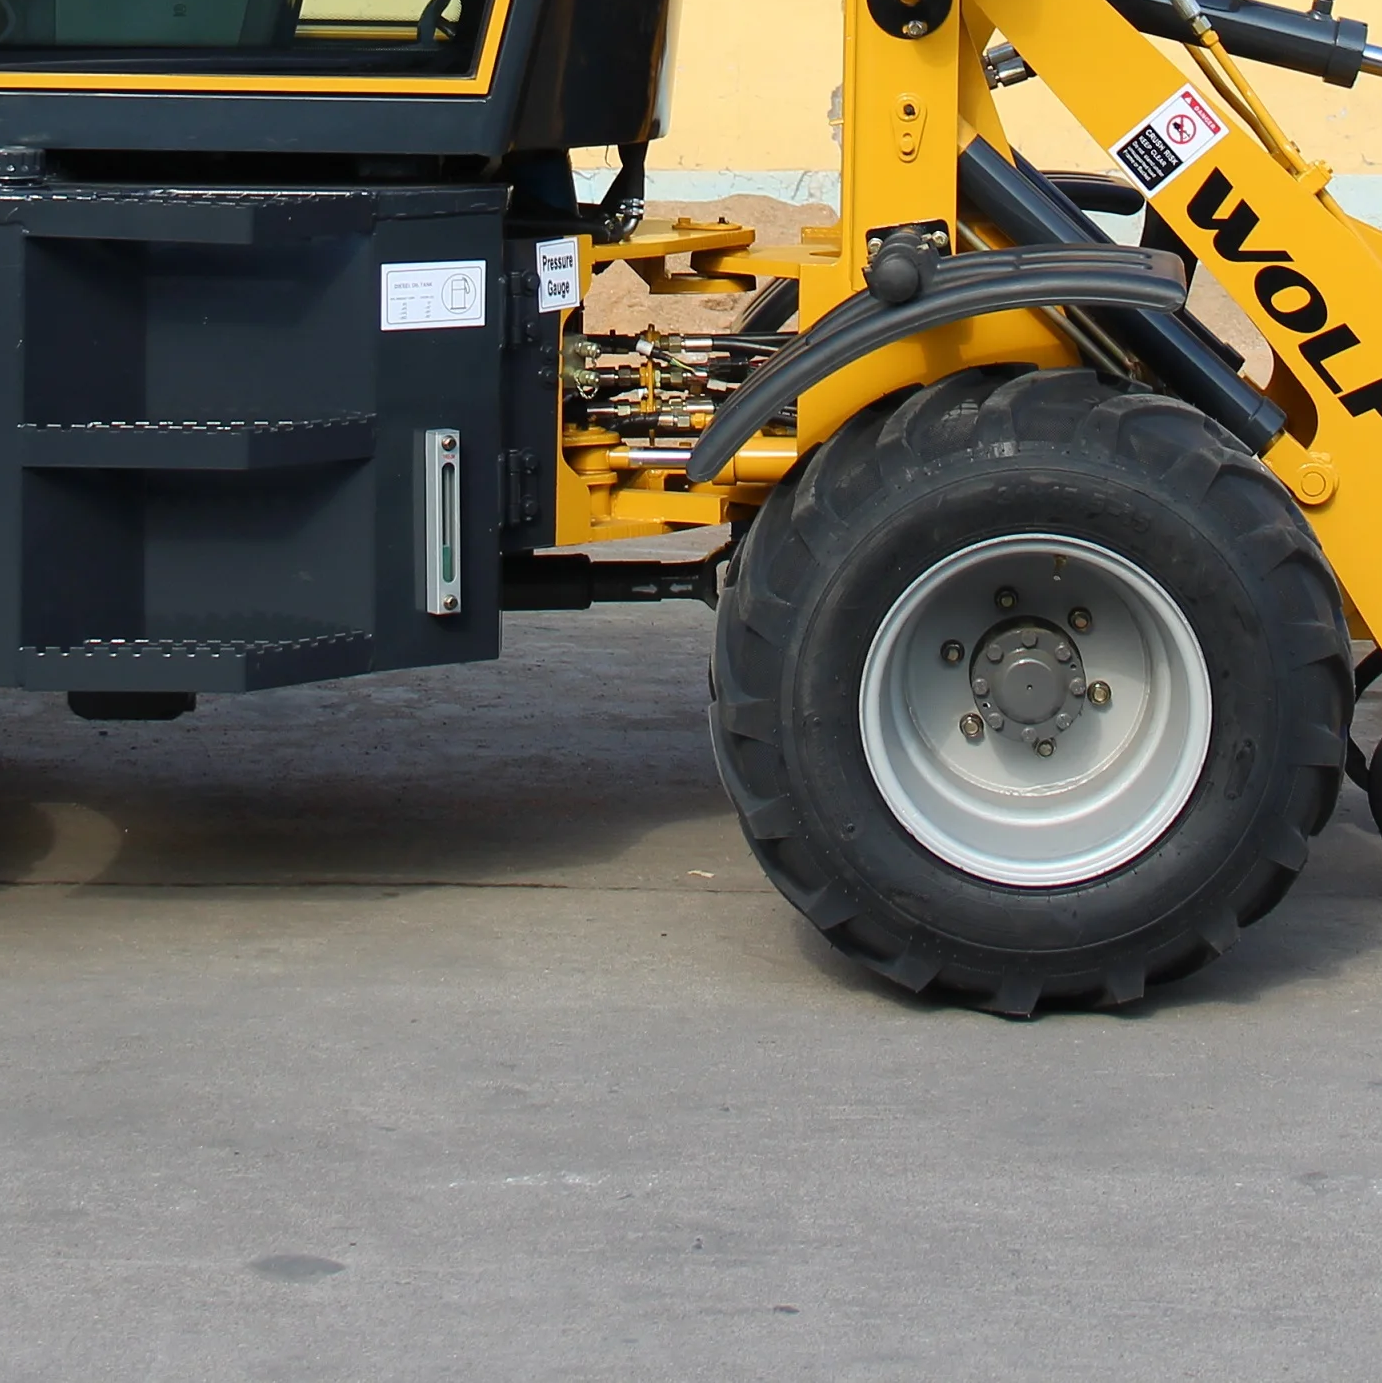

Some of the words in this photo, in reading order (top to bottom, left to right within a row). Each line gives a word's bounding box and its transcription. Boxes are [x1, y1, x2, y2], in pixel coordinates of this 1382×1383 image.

[1193, 105, 1217, 130] DANGER
[1137, 135, 1154, 152] KEEP
[1149, 148, 1168, 168] CLEAR
[1144, 128, 1167, 152] CRUSH
[1162, 148, 1180, 167] RISK
[542, 254, 573, 271] Pressure
[547, 279, 570, 299] Gauge
